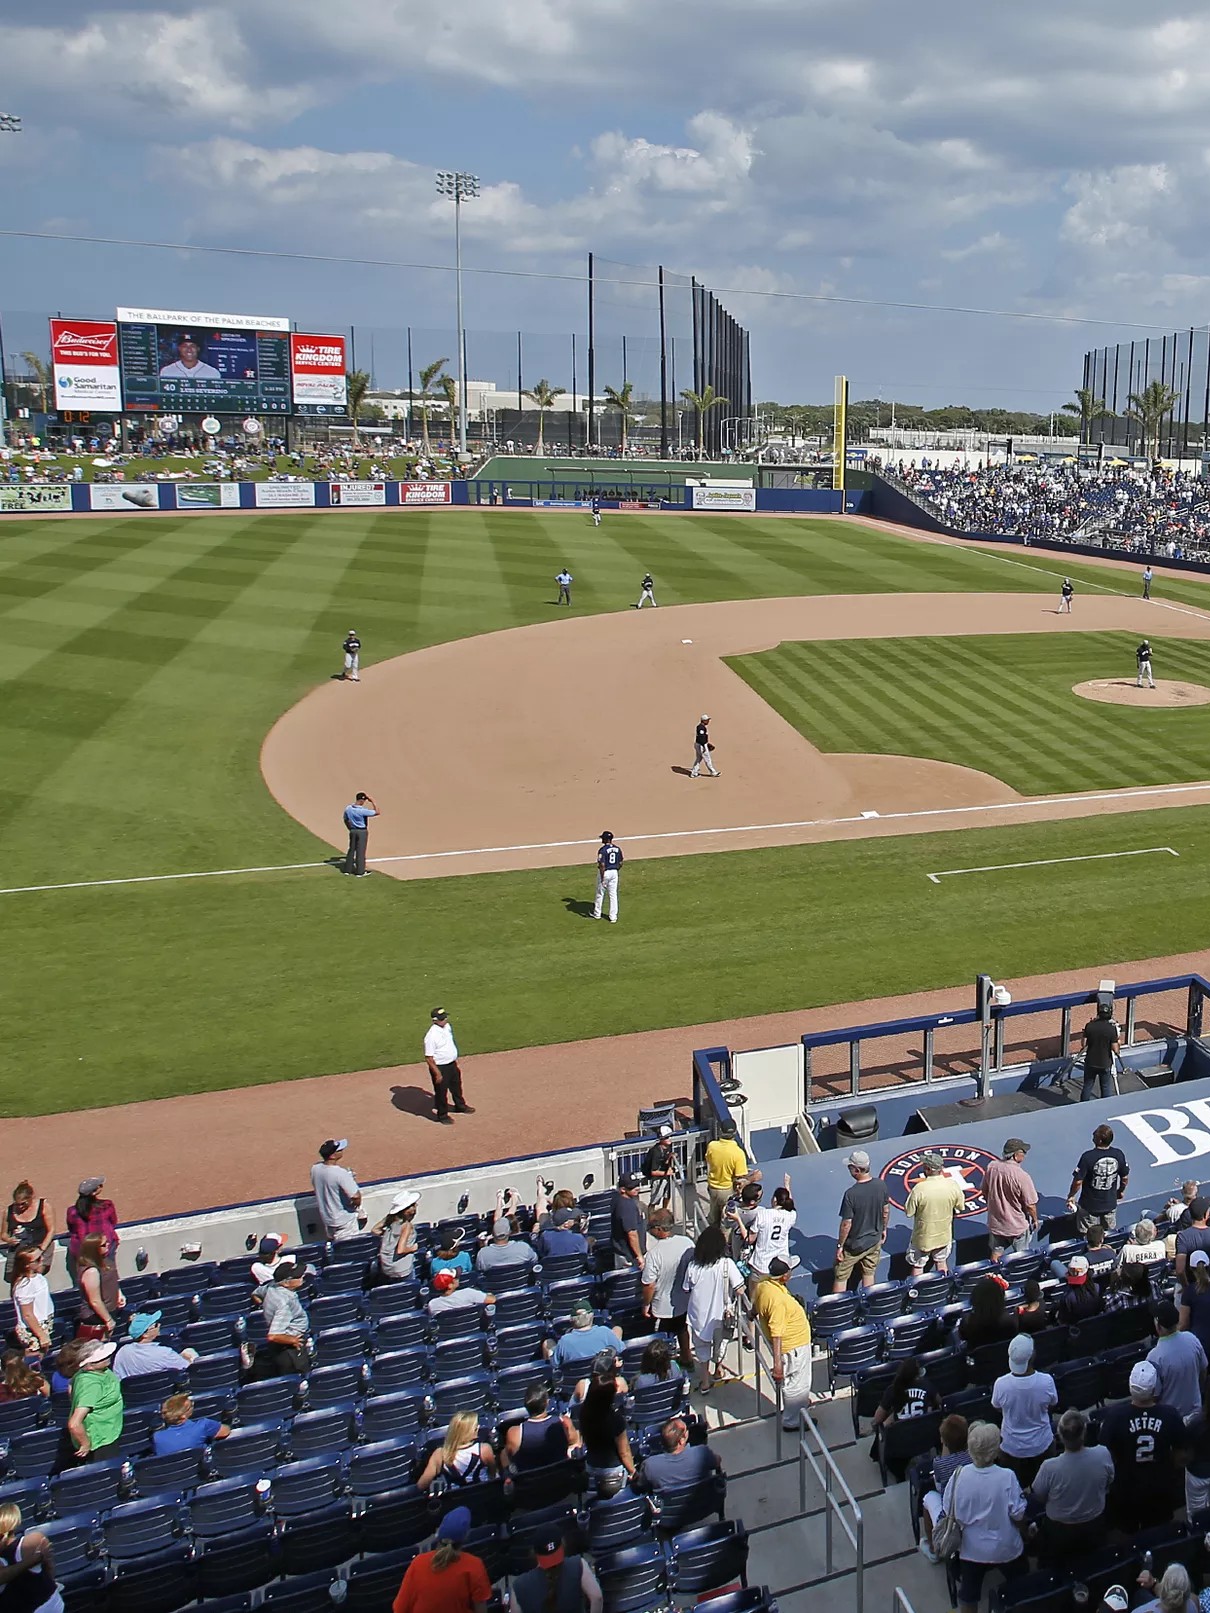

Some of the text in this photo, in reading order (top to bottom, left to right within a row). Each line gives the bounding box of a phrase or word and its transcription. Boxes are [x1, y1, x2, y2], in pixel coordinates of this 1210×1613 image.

[147, 313, 188, 321] BALLPARK
[205, 316, 221, 324] THE
[222, 317, 244, 325] PALM
[245, 319, 281, 327] BEACHES
[60, 334, 110, 345] Budweiser
[318, 346, 342, 355] TIRE
[295, 353, 342, 362] KINGDOM
[73, 382, 117, 390] Samaritan
[74, 376, 97, 384] Good
[609, 852, 616, 864] 8
[889, 1148, 981, 1176] HOUSTON
[771, 1225, 782, 1240] 2
[1135, 1252, 1157, 1261] BERRA
[897, 1401, 924, 1419] 46
[1129, 1417, 1163, 1433] JETER
[1136, 1435, 1155, 1462] 2
